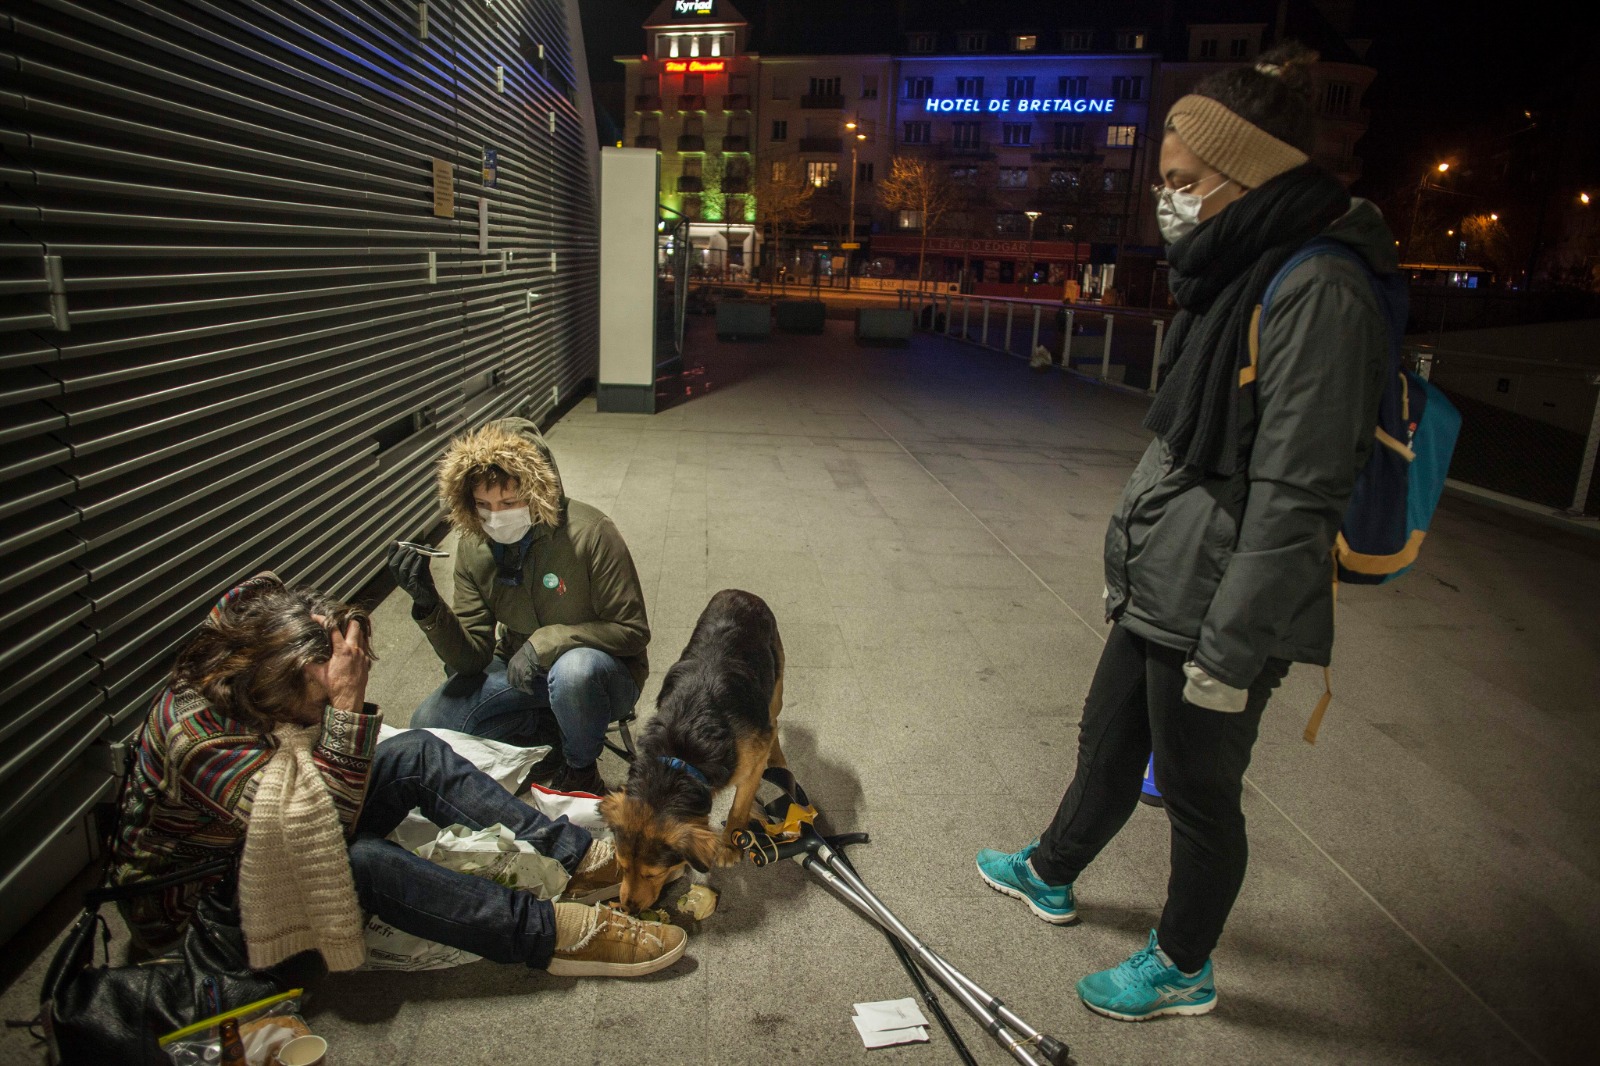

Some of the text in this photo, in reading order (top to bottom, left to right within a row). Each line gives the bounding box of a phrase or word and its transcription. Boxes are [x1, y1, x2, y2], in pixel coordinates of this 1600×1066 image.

[675, 0, 713, 14] Kyriad
[925, 98, 1115, 112] HOTEL DE BRETAGNE
[368, 921, 394, 938] ur.fr
